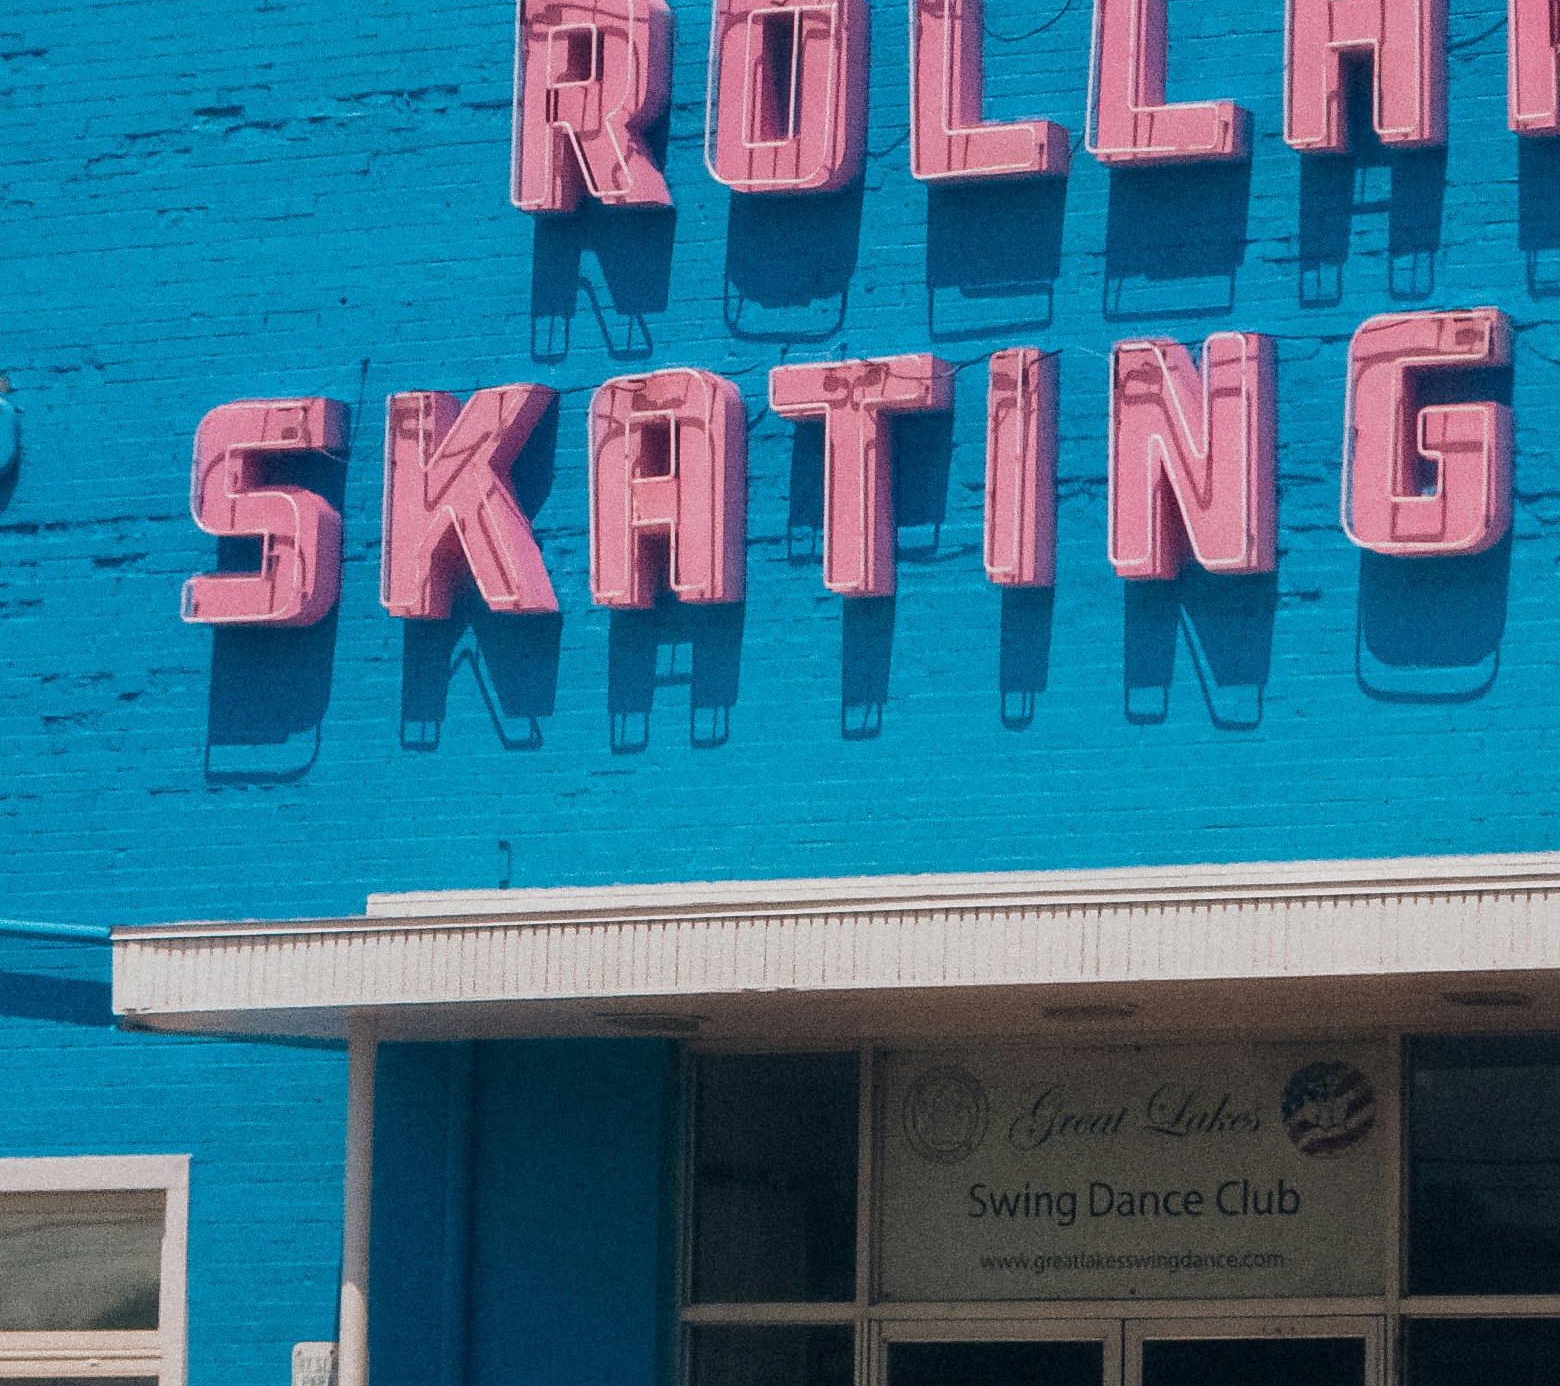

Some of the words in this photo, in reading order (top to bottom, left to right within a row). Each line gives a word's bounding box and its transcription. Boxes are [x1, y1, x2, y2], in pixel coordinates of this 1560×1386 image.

[181, 307, 1512, 626] SKATING
[1008, 1082, 1128, 1151] Great
[1145, 1082, 1263, 1138] Lakes
[968, 1182, 1077, 1226] Swing
[1088, 1182, 1203, 1217] Dance
[1215, 1179, 1302, 1216] Club
